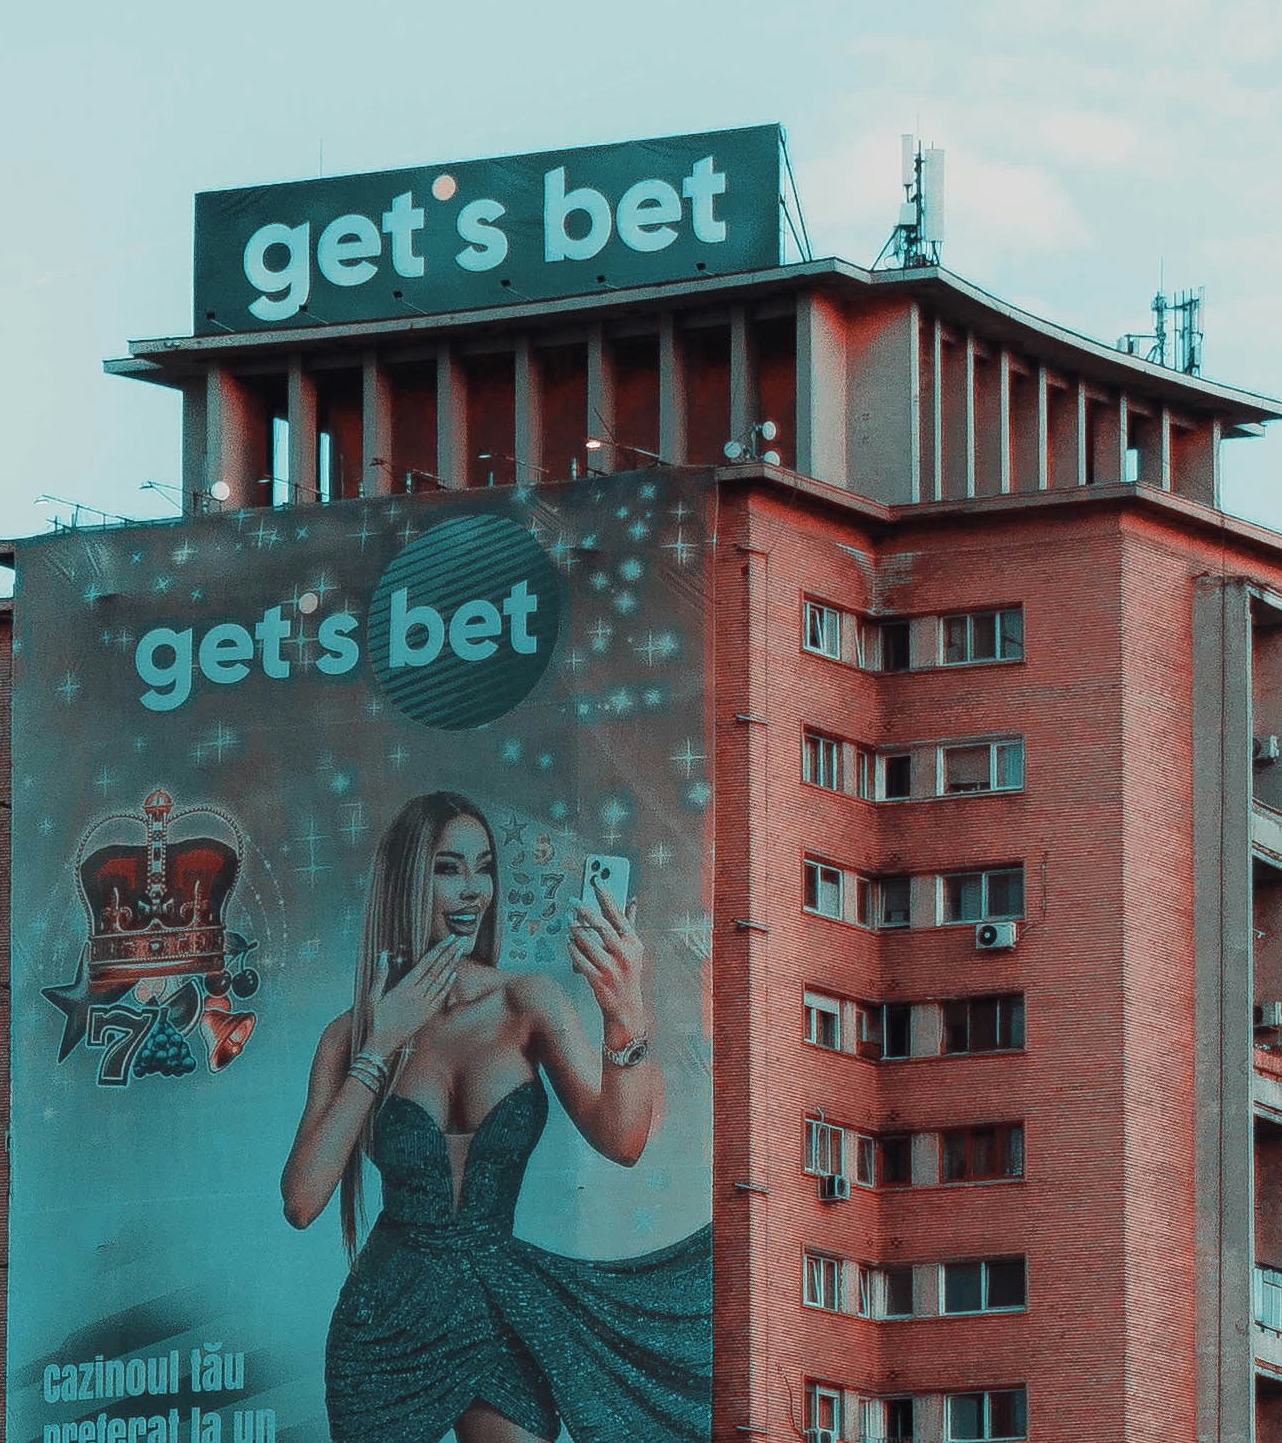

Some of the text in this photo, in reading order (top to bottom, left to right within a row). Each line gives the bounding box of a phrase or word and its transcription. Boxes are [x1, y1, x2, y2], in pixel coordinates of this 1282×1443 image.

[243, 156, 726, 321] get's bet
[134, 580, 537, 712] get's bet
[43, 1342, 245, 1403] cazinoul tău
